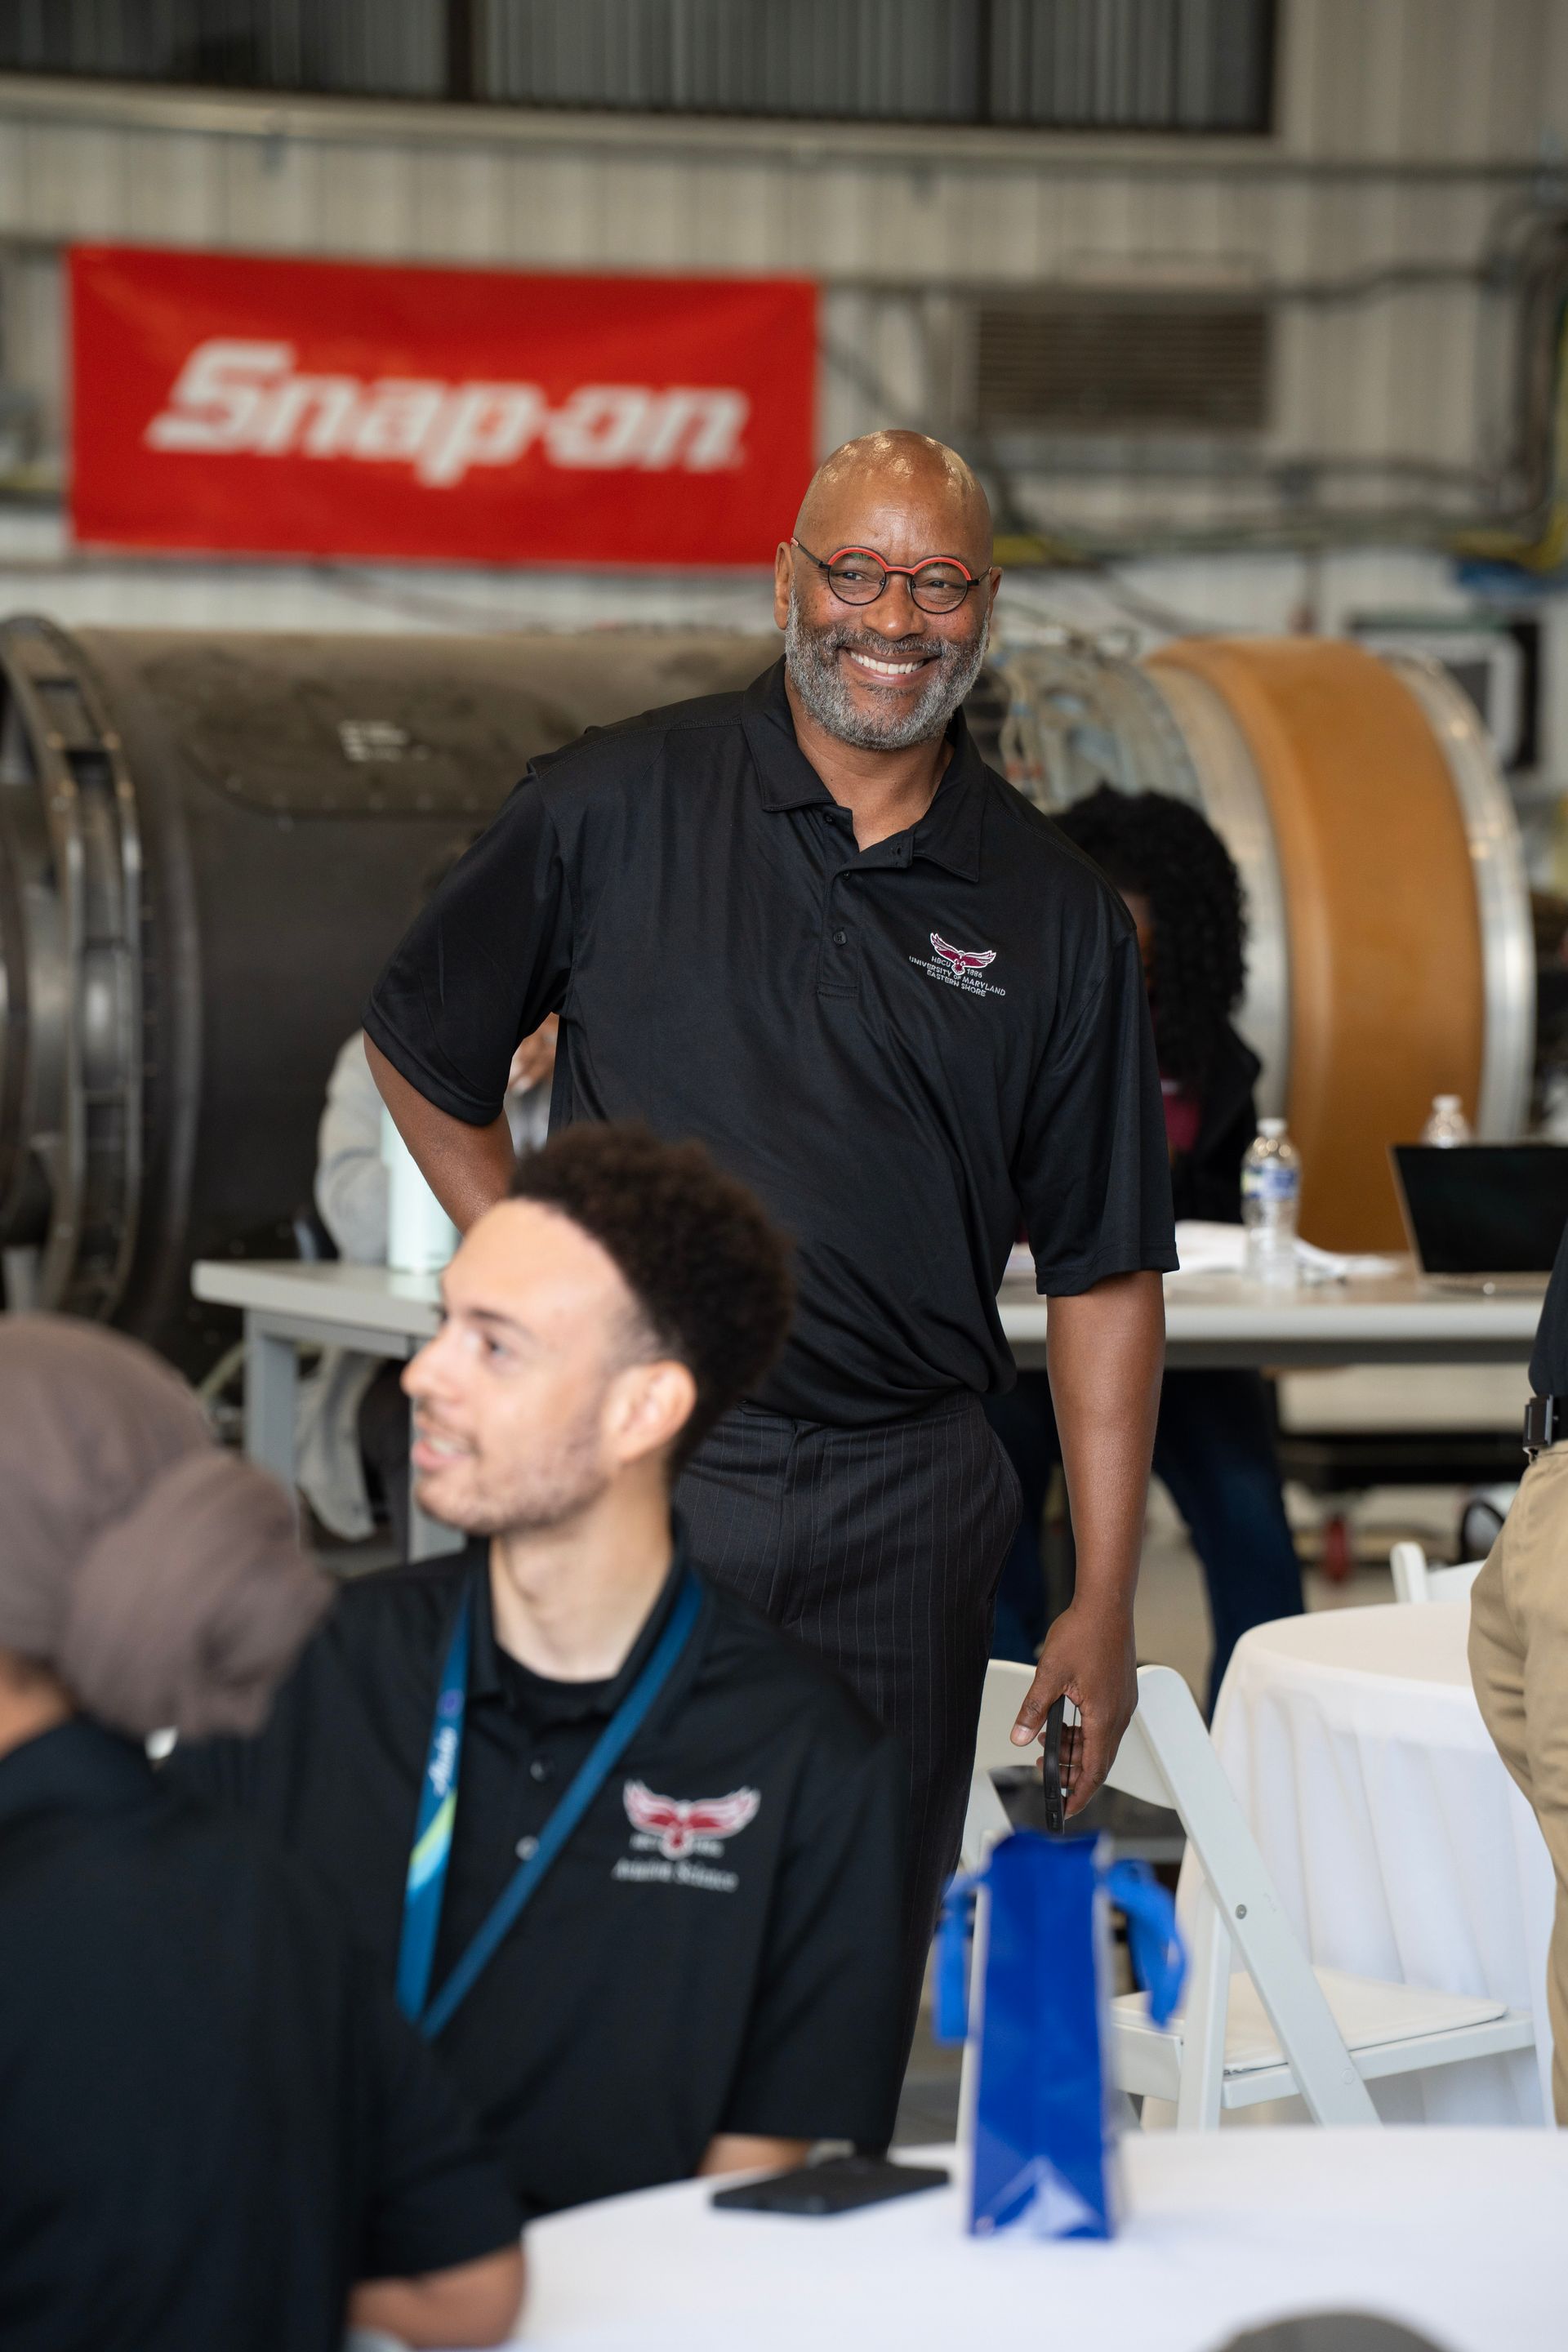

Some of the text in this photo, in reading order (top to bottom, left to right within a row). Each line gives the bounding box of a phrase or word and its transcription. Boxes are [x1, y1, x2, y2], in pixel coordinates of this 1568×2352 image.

[144, 338, 747, 488] Snap-on
[908, 956, 952, 978] UNIVERSITY
[962, 976, 1006, 996] MARYLAND
[926, 969, 987, 997] EASTERN SHORE
[931, 956, 982, 978] HBCU 1886
